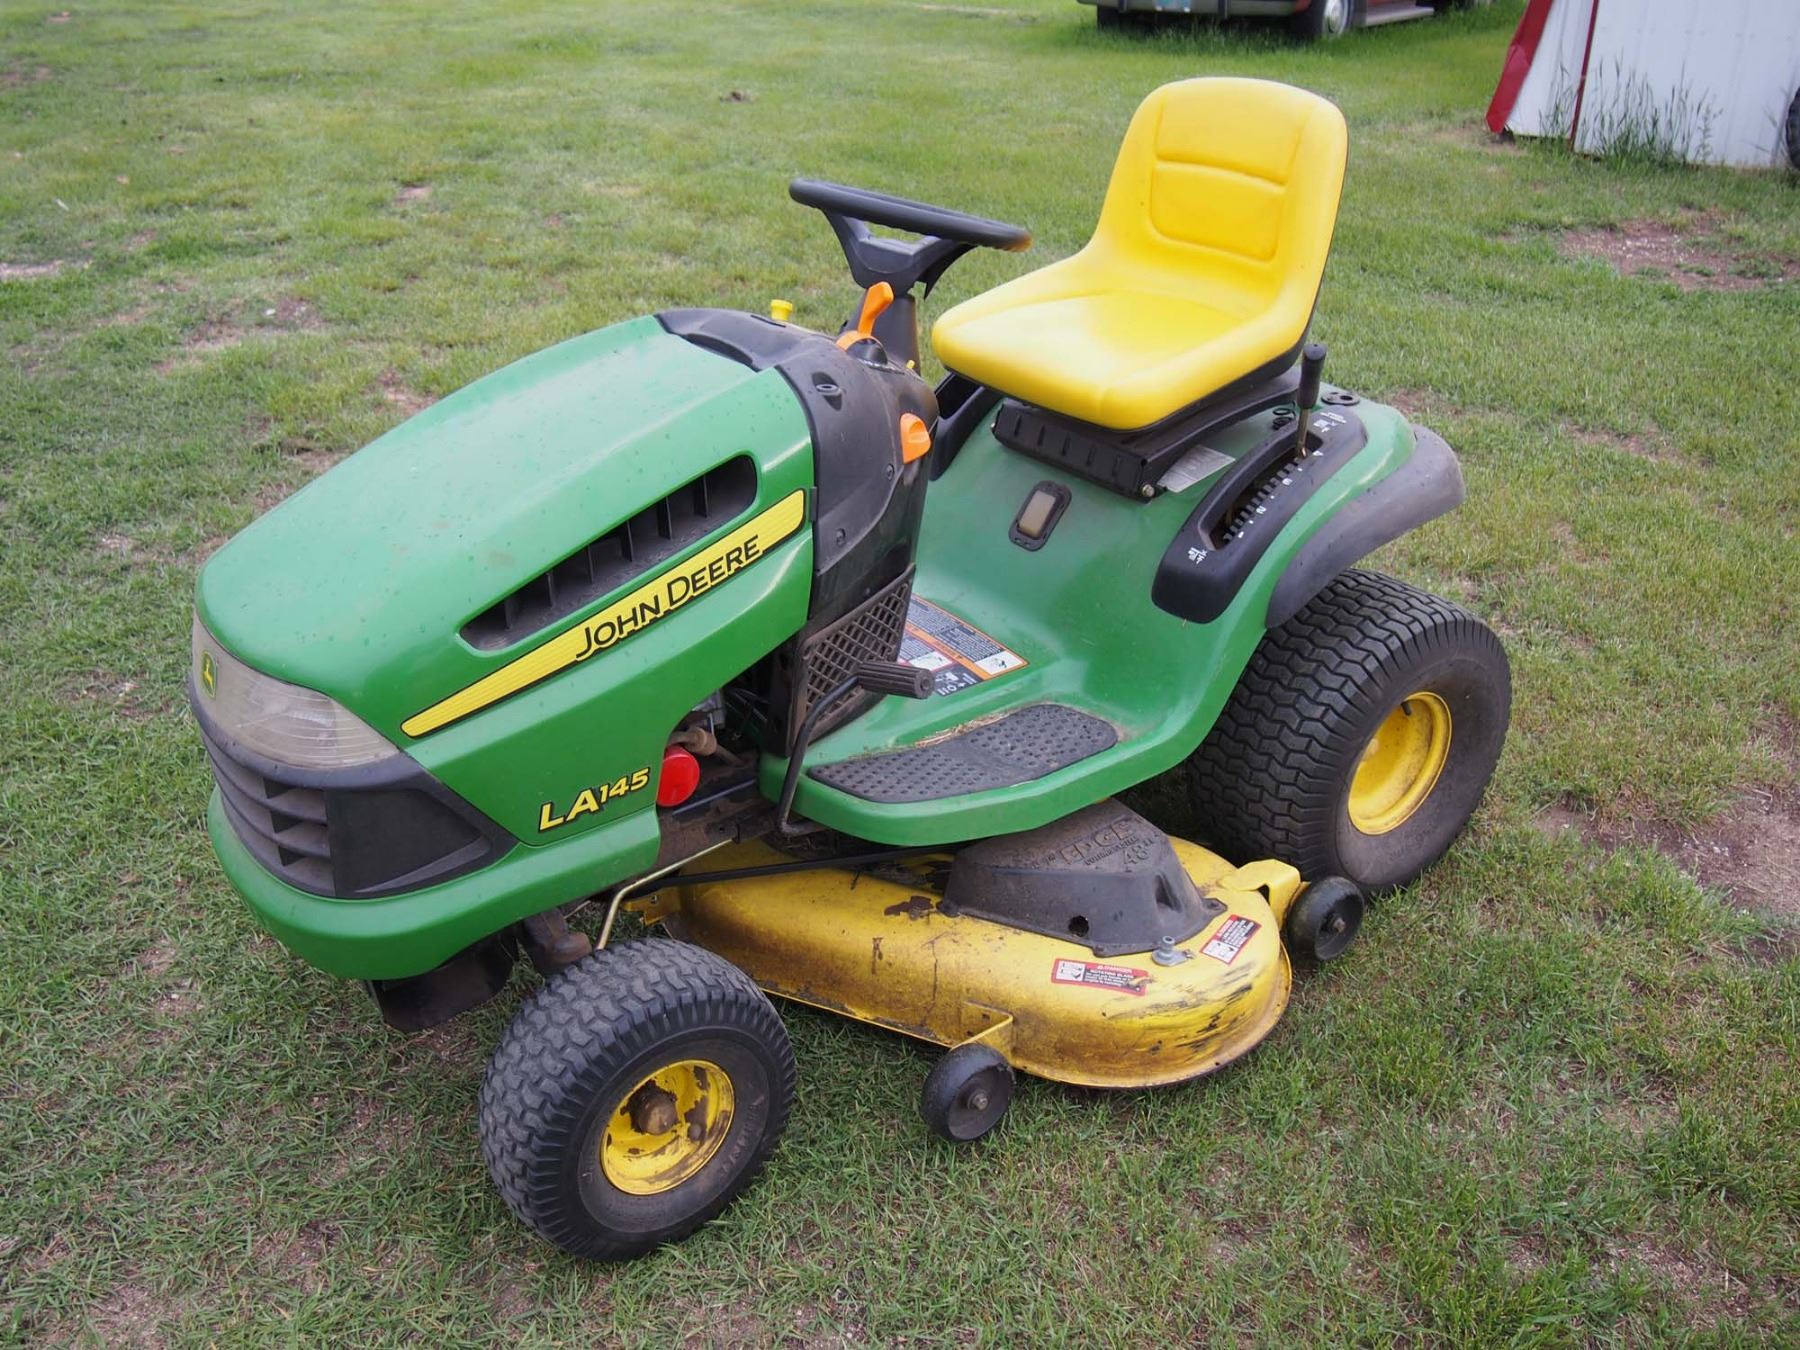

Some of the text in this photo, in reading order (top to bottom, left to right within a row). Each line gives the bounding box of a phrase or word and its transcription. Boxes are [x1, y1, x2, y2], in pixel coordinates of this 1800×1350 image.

[576, 534, 762, 659] JOHN DEERE
[538, 766, 651, 834] LA145
